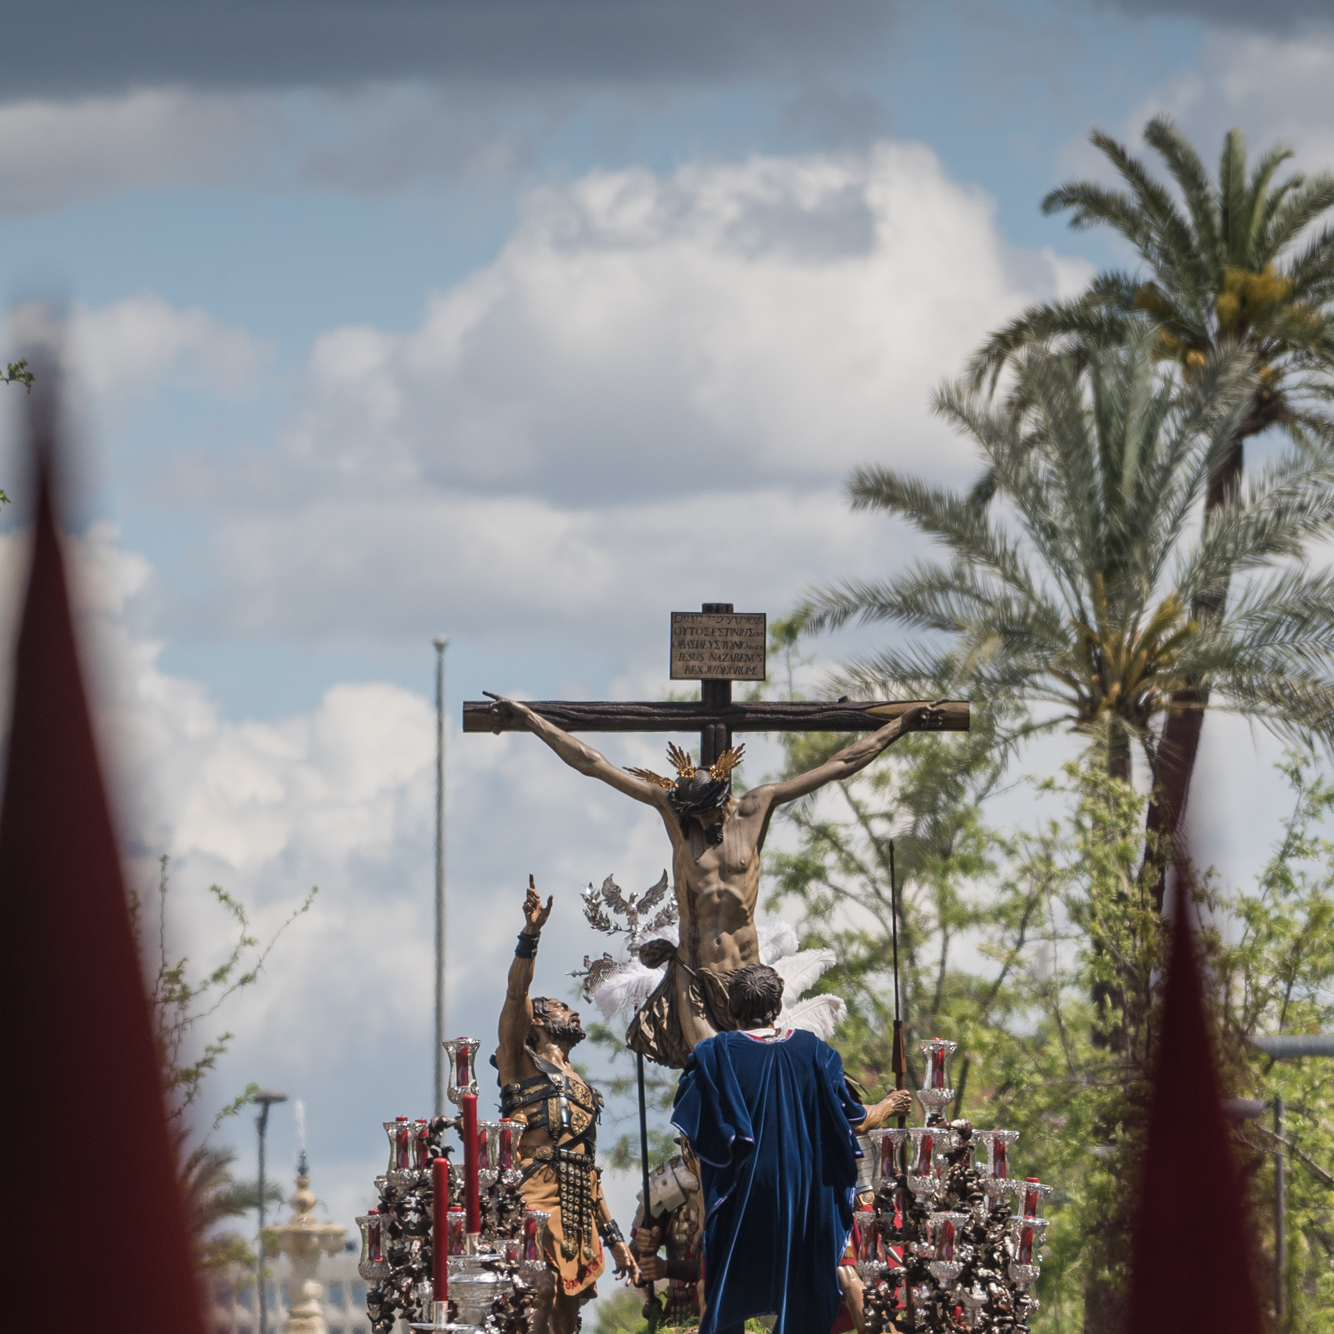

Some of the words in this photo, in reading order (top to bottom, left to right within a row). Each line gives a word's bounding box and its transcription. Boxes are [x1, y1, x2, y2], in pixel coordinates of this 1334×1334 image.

[678, 653, 705, 662] IESUS
[708, 653, 763, 663] NAZARENUS
[684, 665, 704, 674] REX
